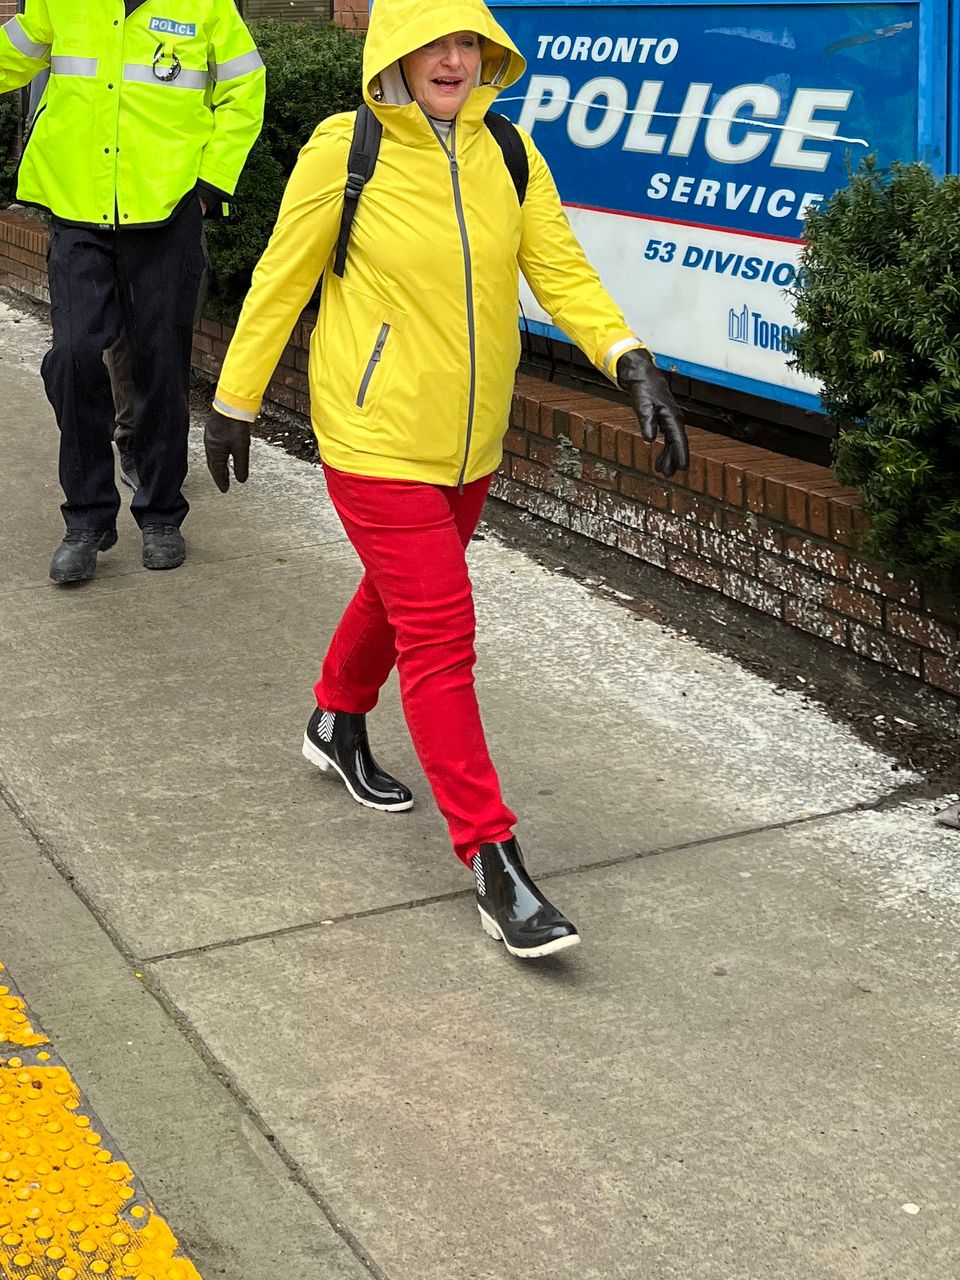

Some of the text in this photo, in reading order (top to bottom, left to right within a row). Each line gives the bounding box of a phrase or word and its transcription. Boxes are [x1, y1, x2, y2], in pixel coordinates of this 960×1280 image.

[538, 35, 679, 65] TORONTO
[518, 74, 854, 173] POLICE
[647, 172, 824, 221] SERVICE
[644, 239, 813, 287] 53 DIVISIO
